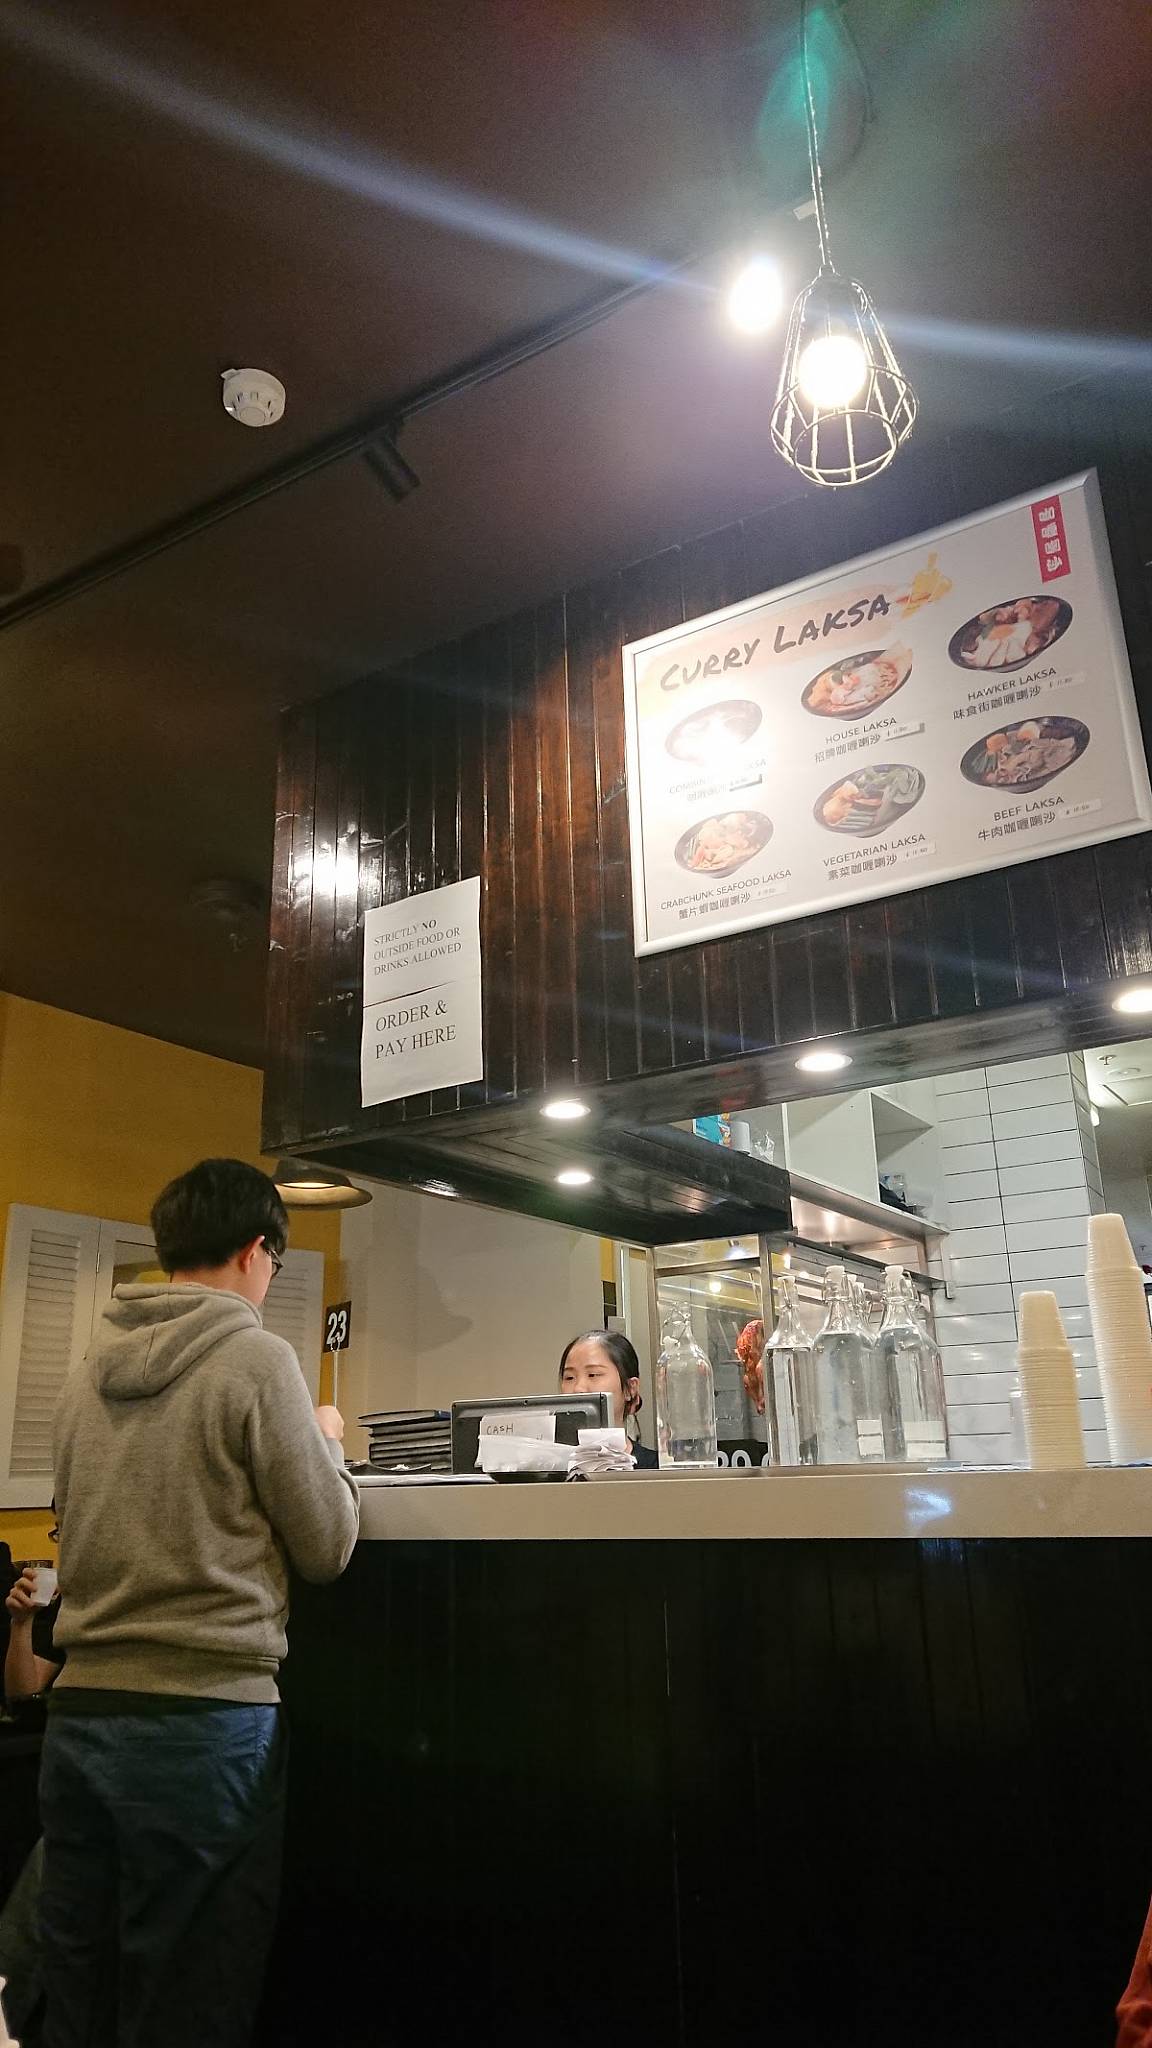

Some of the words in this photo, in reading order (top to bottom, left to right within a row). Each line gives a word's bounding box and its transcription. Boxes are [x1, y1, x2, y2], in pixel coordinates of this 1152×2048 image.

[661, 639, 760, 691] CURRY
[773, 594, 890, 653] LAKSA
[968, 680, 1016, 701] HAWKER
[1020, 667, 1057, 685] LAKSA
[825, 727, 860, 744] HOUSE
[863, 717, 897, 733] LAKSA
[994, 806, 1022, 821] BEEF
[1026, 796, 1065, 812] LAKSA
[823, 843, 888, 866] VEGETARIAN
[892, 833, 926, 849] LAKSA
[661, 890, 714, 910] CRABCHUNK
[716, 877, 760, 896] SEAFOOD
[762, 869, 792, 884] LAKSA
[374, 924, 418, 944] STRICTLY
[422, 919, 437, 930] NO
[374, 941, 414, 961] OUTSIDE
[417, 932, 444, 948] FOOD
[445, 927, 460, 939] OR
[374, 957, 409, 976] DRINKS
[411, 942, 462, 964] ALLOWED
[376, 1003, 430, 1032] ORDER
[435, 1000, 449, 1016] &
[375, 1036, 408, 1060] PAY
[411, 1024, 458, 1050] HERE
[326, 1310, 347, 1345] 23
[486, 1423, 514, 1436] CASH
